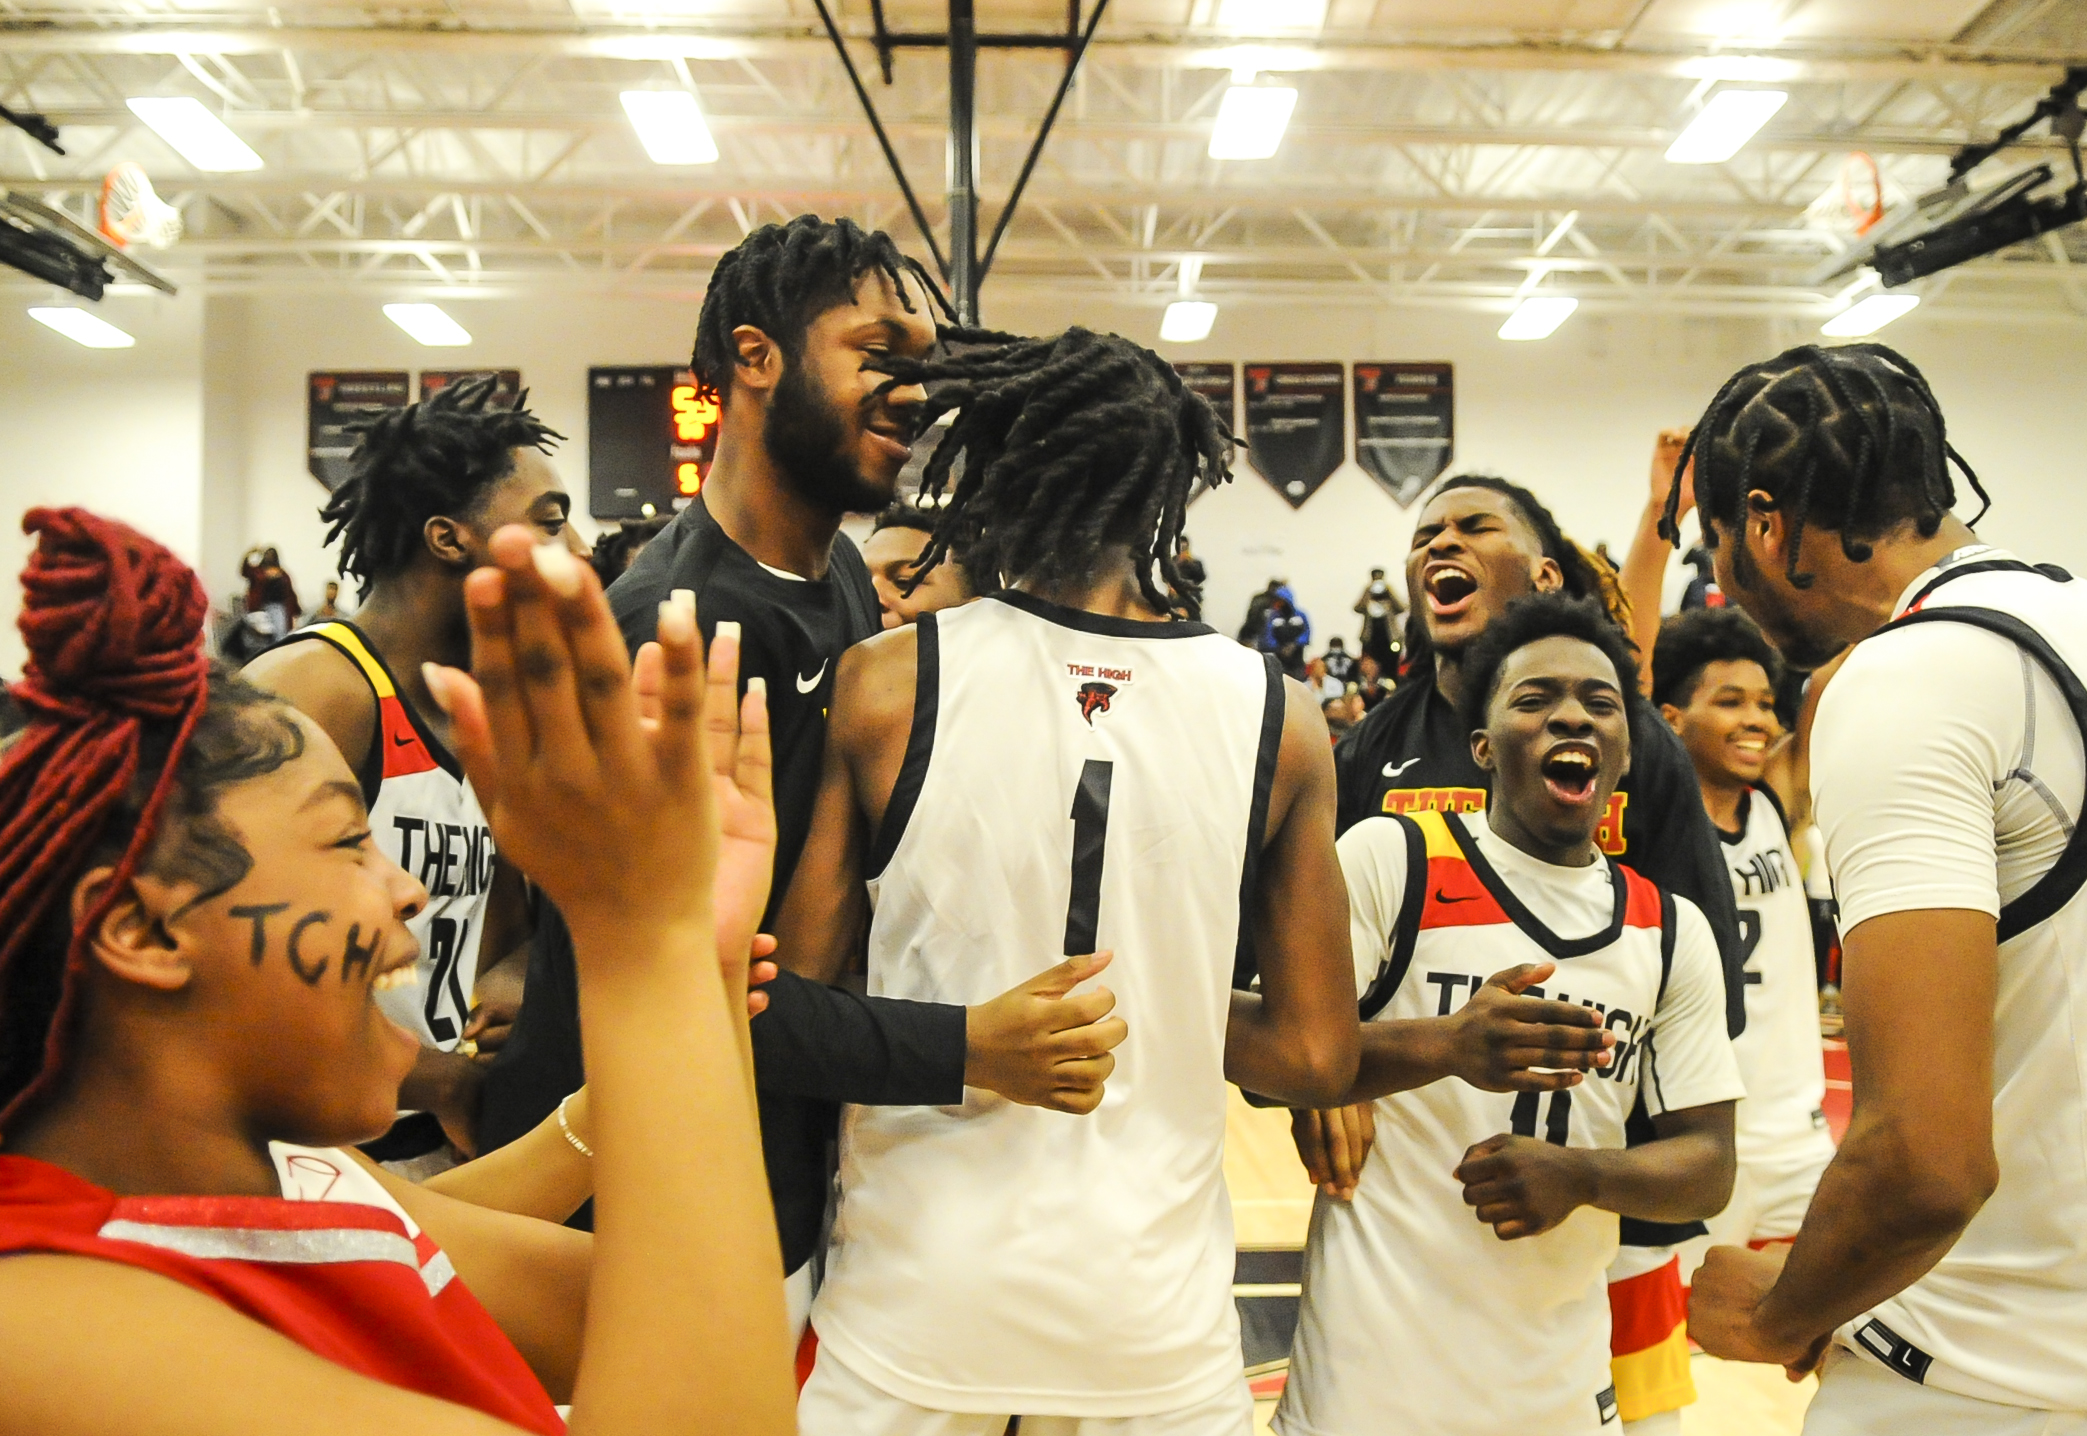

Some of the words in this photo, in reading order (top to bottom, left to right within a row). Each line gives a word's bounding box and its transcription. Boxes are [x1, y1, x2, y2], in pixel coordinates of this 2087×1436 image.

[1067, 663, 1095, 677] THE
[1098, 667, 1132, 681] HIGH
[393, 816, 462, 896] THE
[1063, 759, 1114, 957] 1
[228, 902, 383, 987] TCH
